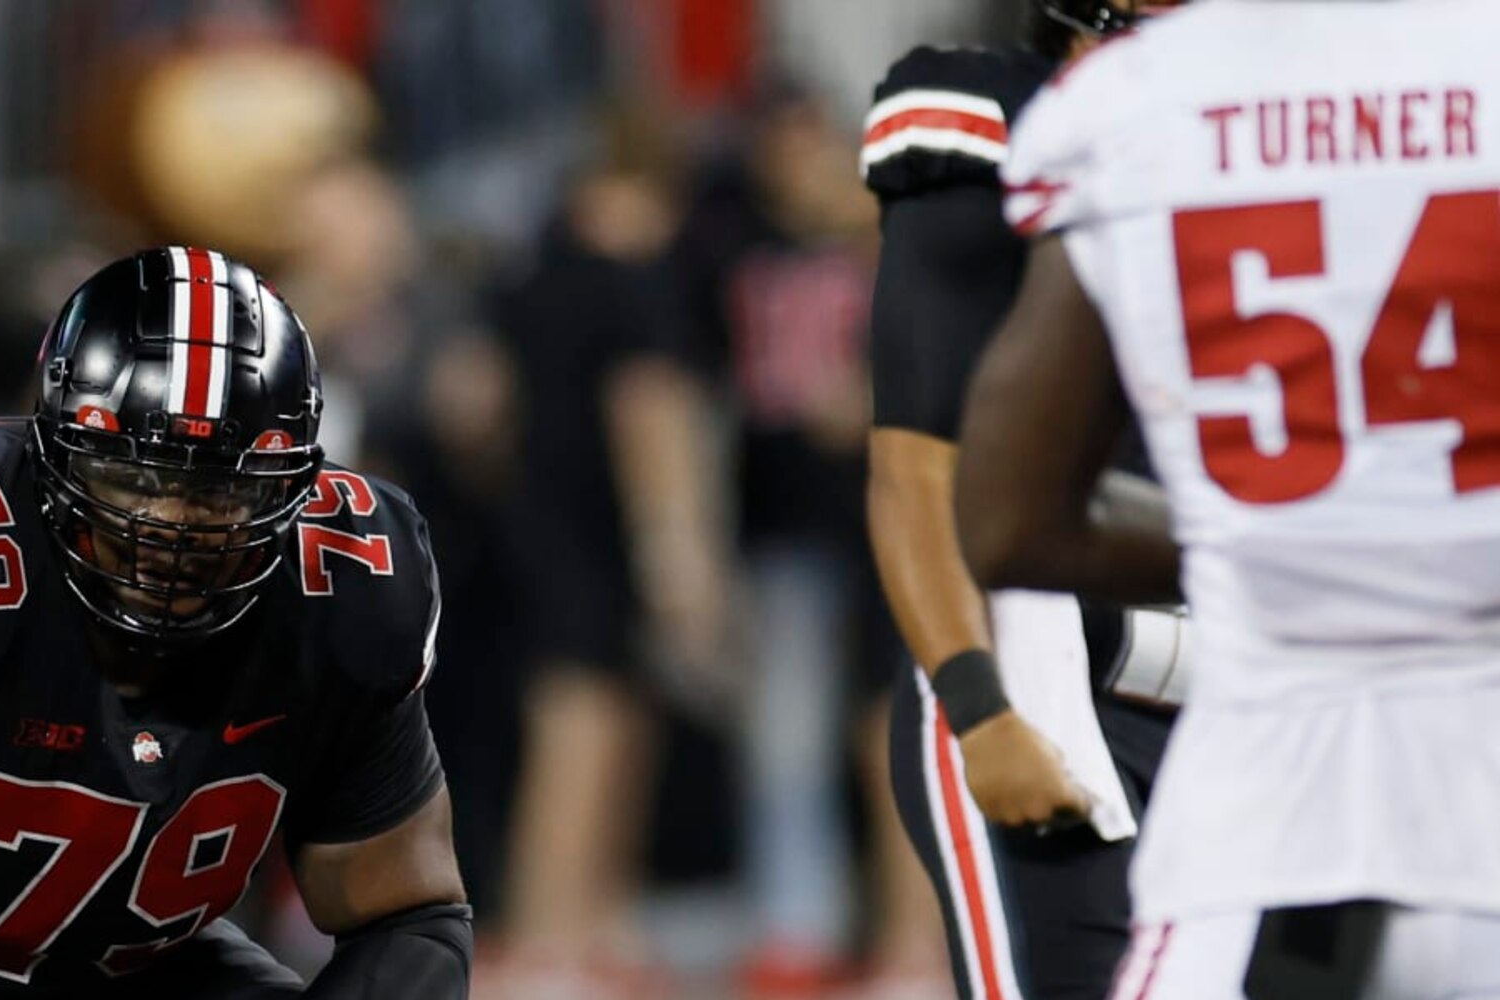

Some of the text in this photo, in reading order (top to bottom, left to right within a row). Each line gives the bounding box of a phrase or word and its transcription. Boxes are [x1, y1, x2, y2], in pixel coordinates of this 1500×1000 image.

[1202, 88, 1479, 173] TURNER
[1171, 188, 1500, 508] 54
[297, 469, 394, 596] 79
